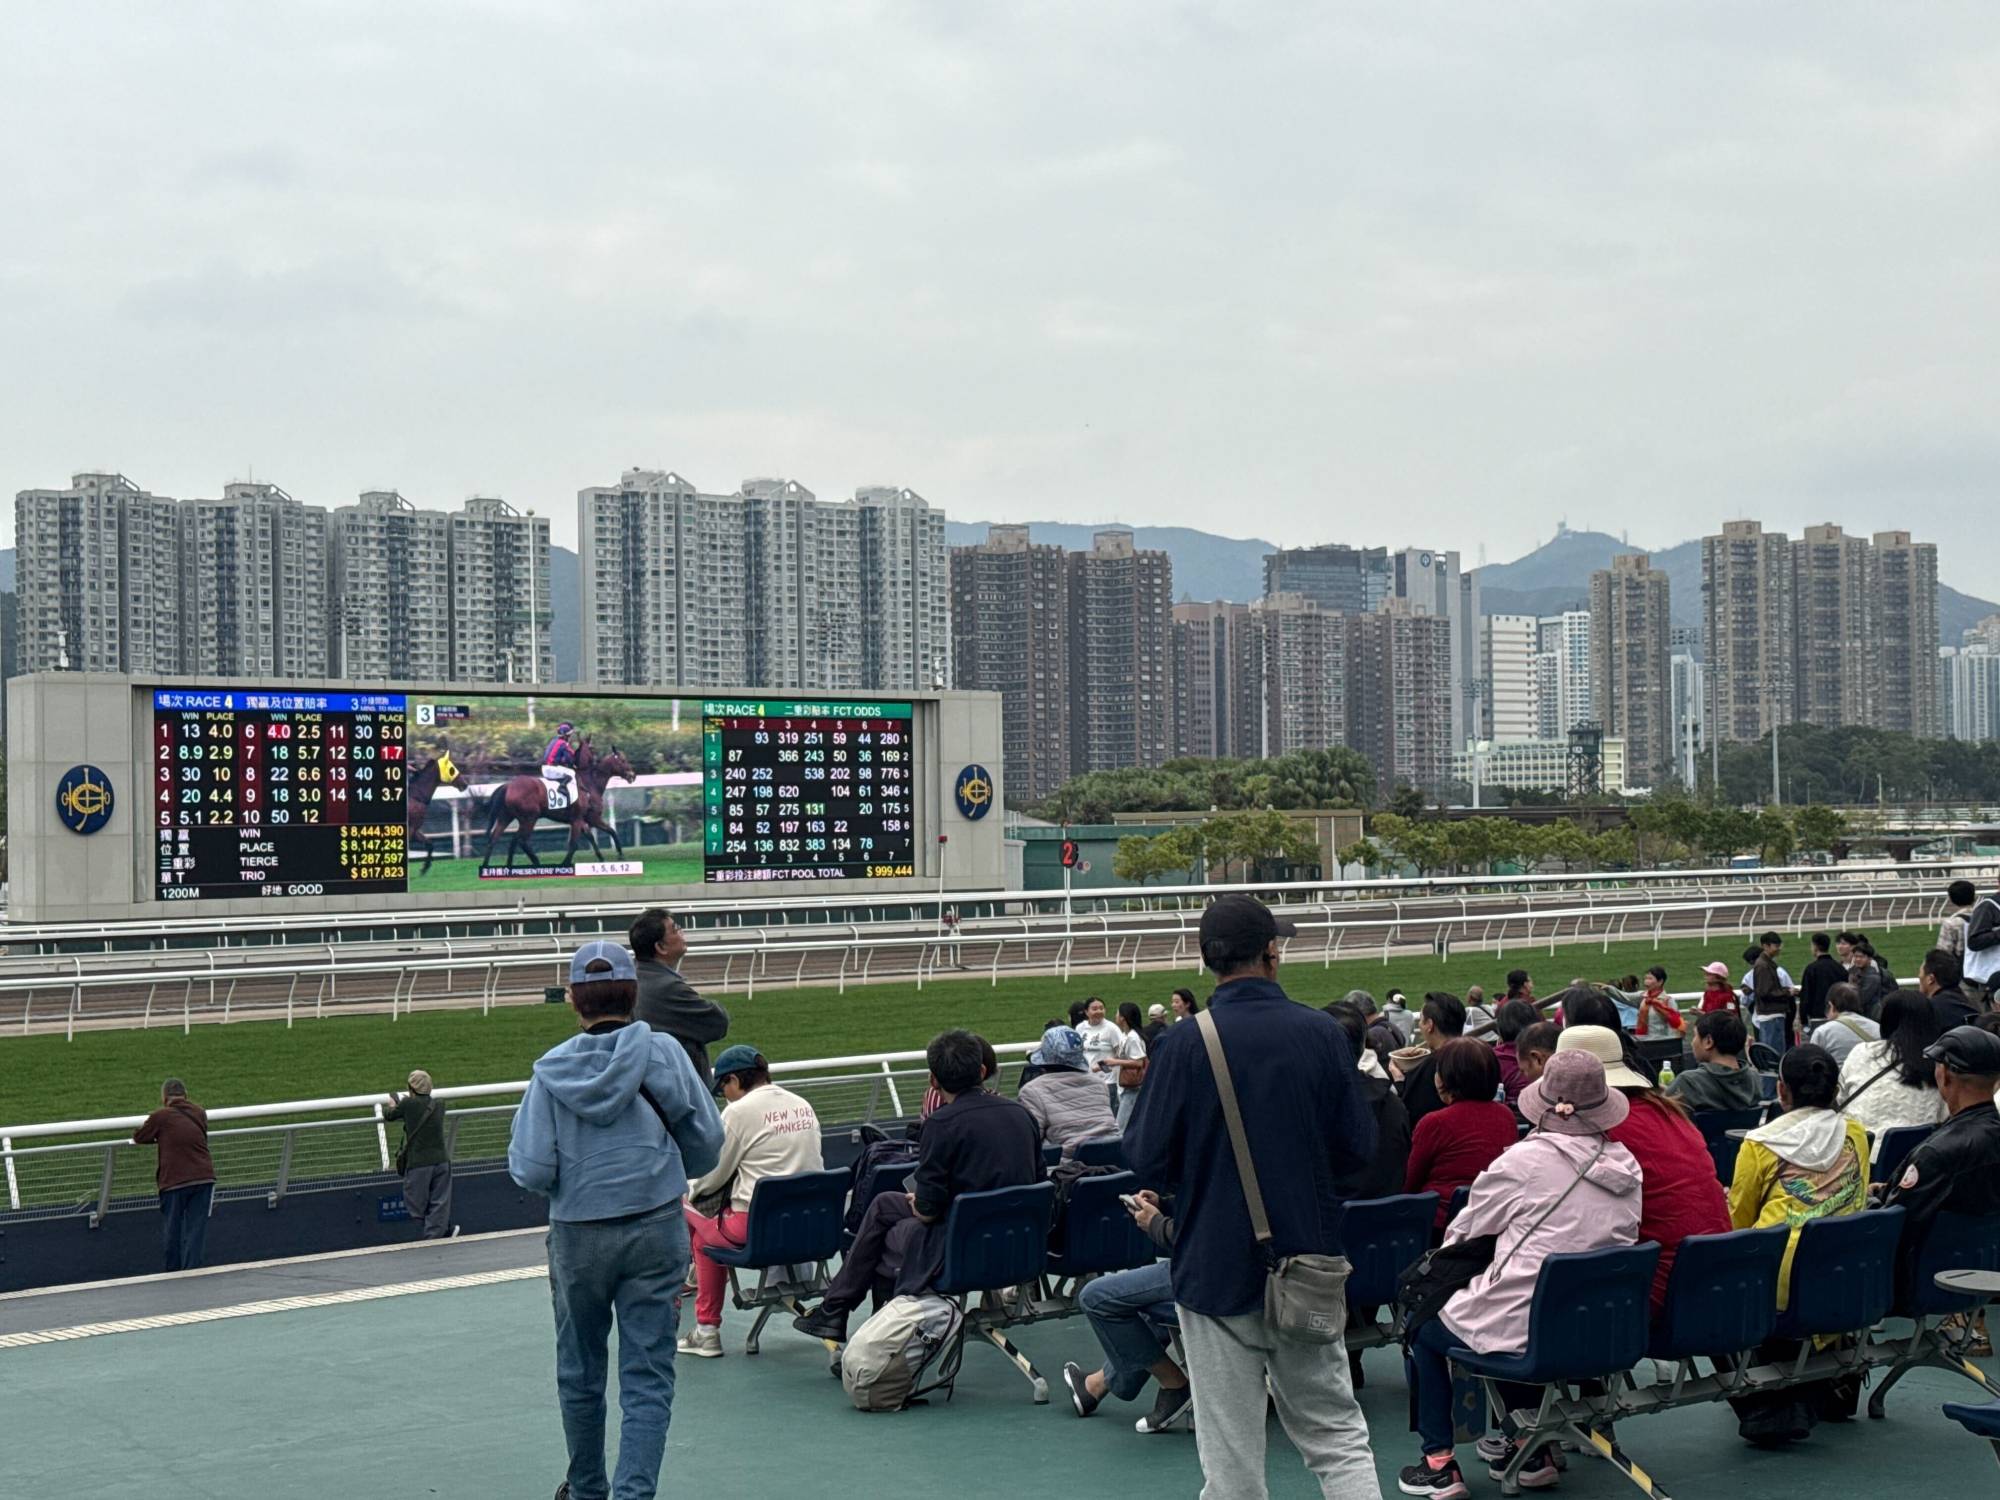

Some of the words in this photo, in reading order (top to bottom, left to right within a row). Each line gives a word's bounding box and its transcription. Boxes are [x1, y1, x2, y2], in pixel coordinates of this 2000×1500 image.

[186, 696, 221, 707] RACE
[225, 695, 232, 708] 4
[351, 698, 359, 710] 3
[420, 707, 431, 722] 3
[727, 705, 756, 715] RACE
[758, 704, 765, 716] 4
[833, 706, 852, 716] FCT
[854, 706, 881, 716] ODDS
[182, 712, 199, 720] WIN
[207, 712, 234, 720] PLACE
[295, 713, 322, 721] PLACE
[379, 714, 404, 722] PLACE
[161, 724, 167, 737] 1
[183, 724, 200, 737] 13
[209, 724, 232, 738] 4.0
[246, 725, 254, 738] 6
[268, 725, 290, 738] 4.0
[298, 725, 320, 738] 2.5
[330, 726, 343, 738] 11
[355, 725, 372, 739] 30
[382, 726, 402, 739] 5.0
[733, 720, 737, 728] 1
[759, 720, 764, 729] 2
[786, 720, 791, 729] 3
[837, 721, 842, 729] 5
[862, 721, 867, 730] 6
[887, 721, 892, 729] 7
[711, 733, 715, 742] 1
[755, 732, 769, 744] 93
[778, 732, 798, 744] 319
[804, 733, 822, 744] 251
[833, 733, 846, 744] 59
[858, 733, 871, 744] 44
[880, 733, 899, 744] 280
[160, 745, 169, 759] 2
[180, 745, 202, 759] 8.9
[210, 746, 232, 759] 2.9
[246, 746, 254, 759] 7
[272, 746, 288, 759] 18
[299, 746, 320, 759] 5.7
[330, 746, 346, 759] 12
[354, 746, 374, 759] 5.0
[382, 746, 402, 759] 1.7
[710, 751, 716, 760] 2
[729, 750, 742, 761] 87
[779, 750, 798, 761] 366
[805, 750, 824, 761] 243
[834, 750, 846, 761] 50
[859, 750, 872, 762] 36
[882, 751, 899, 761] 169
[161, 767, 169, 781] 3
[182, 767, 200, 781] 30
[213, 767, 230, 781] 10
[246, 767, 255, 781] 8
[271, 767, 288, 781] 22
[298, 767, 320, 780] 6.6
[330, 767, 346, 780] 13
[355, 767, 372, 780] 40
[385, 767, 400, 780] 10
[711, 769, 717, 779] 3
[726, 768, 746, 779] 240
[752, 768, 772, 779] 252
[805, 768, 824, 779] 538
[830, 768, 850, 779] 202
[859, 768, 872, 779] 98
[881, 768, 900, 779] 776
[160, 789, 169, 802] 4
[182, 789, 200, 803] 20
[209, 789, 232, 802] 4.4
[246, 789, 255, 802] 9
[272, 788, 288, 802] 18
[299, 788, 320, 802] 3.0
[330, 788, 346, 801] 14
[357, 788, 372, 801] 14
[382, 788, 402, 801] 3.7
[726, 786, 746, 798] 247
[753, 786, 773, 797] 198
[779, 786, 799, 797] 620
[832, 786, 850, 797] 104
[859, 785, 870, 797] 61
[881, 785, 900, 797] 346
[711, 806, 717, 815] 5
[729, 804, 743, 816] 85
[756, 804, 769, 816] 57
[779, 804, 799, 815] 275
[806, 803, 823, 815] 131
[859, 803, 872, 814] 20
[882, 803, 900, 814] 175
[161, 811, 170, 825] 5
[180, 811, 201, 824] 5.1
[210, 810, 233, 824] 2.2
[243, 810, 260, 823] 10
[272, 810, 289, 823] 50
[302, 809, 318, 822] 12
[240, 829, 260, 838] WIN
[711, 824, 717, 833] 6
[730, 822, 743, 834] 84
[756, 822, 770, 833] 52
[780, 821, 799, 833] 197
[806, 821, 825, 832] 163
[834, 821, 847, 832] 22
[882, 820, 900, 831] 158
[240, 842, 274, 852] PLACE
[712, 842, 717, 851] 7
[727, 840, 746, 852] 254
[754, 840, 773, 851] 136
[780, 839, 799, 851] 832
[806, 839, 825, 850] 383
[832, 838, 850, 850] 134
[860, 838, 873, 849] 78
[1063, 842, 1073, 865] 2
[161, 857, 195, 869] 三重彩
[240, 856, 278, 866] TIERCE
[620, 863, 630, 872] 12
[240, 871, 265, 880] TRIO
[772, 869, 789, 879] FCT
[792, 869, 816, 878] POOL
[818, 868, 845, 877] TOTAL
[163, 888, 199, 898] 1200M
[288, 884, 323, 895] GOOD
[763, 1109, 788, 1125] NEW
